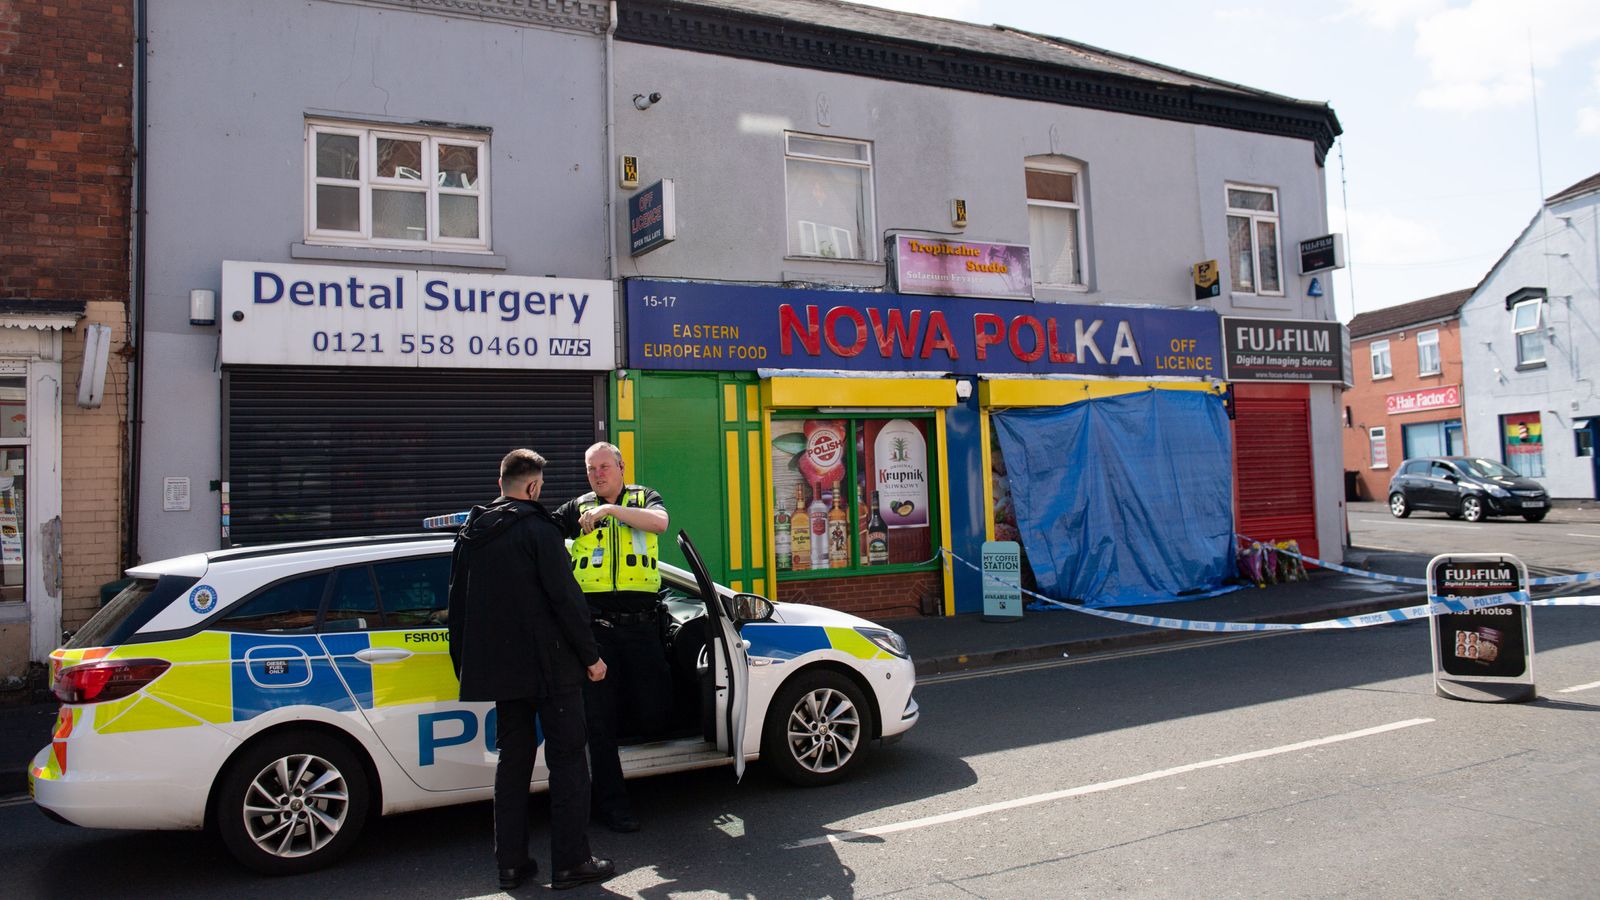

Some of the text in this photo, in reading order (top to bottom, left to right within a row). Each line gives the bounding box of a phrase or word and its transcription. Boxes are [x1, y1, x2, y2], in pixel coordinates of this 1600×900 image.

[640, 192, 654, 211] OFF
[631, 205, 663, 234] LICENCE
[633, 238, 644, 248] OPEN
[908, 240, 981, 257] Tropikalne
[966, 260, 1008, 273] Studio
[254, 271, 589, 324] Dental Surgery
[643, 295, 677, 307] 15-17
[673, 324, 739, 339] EASTERN
[778, 303, 1143, 366] NOWA POLKA
[313, 331, 591, 356] 0121 558 0460 NHS
[1170, 339, 1197, 352] OFF
[644, 344, 767, 359] EUROPEAN FOOD
[1155, 356, 1214, 370] LICENCE
[1236, 355, 1333, 368] Digital Imaging Service
[1396, 393, 1446, 409] Hair Factor
[807, 440, 844, 457] POLISH
[880, 469, 924, 484] Krupnik
[983, 562, 1018, 570] STATION
[1473, 595, 1503, 607] POLICE
[1473, 607, 1513, 615] Photos
[1360, 614, 1384, 624] POLICE
